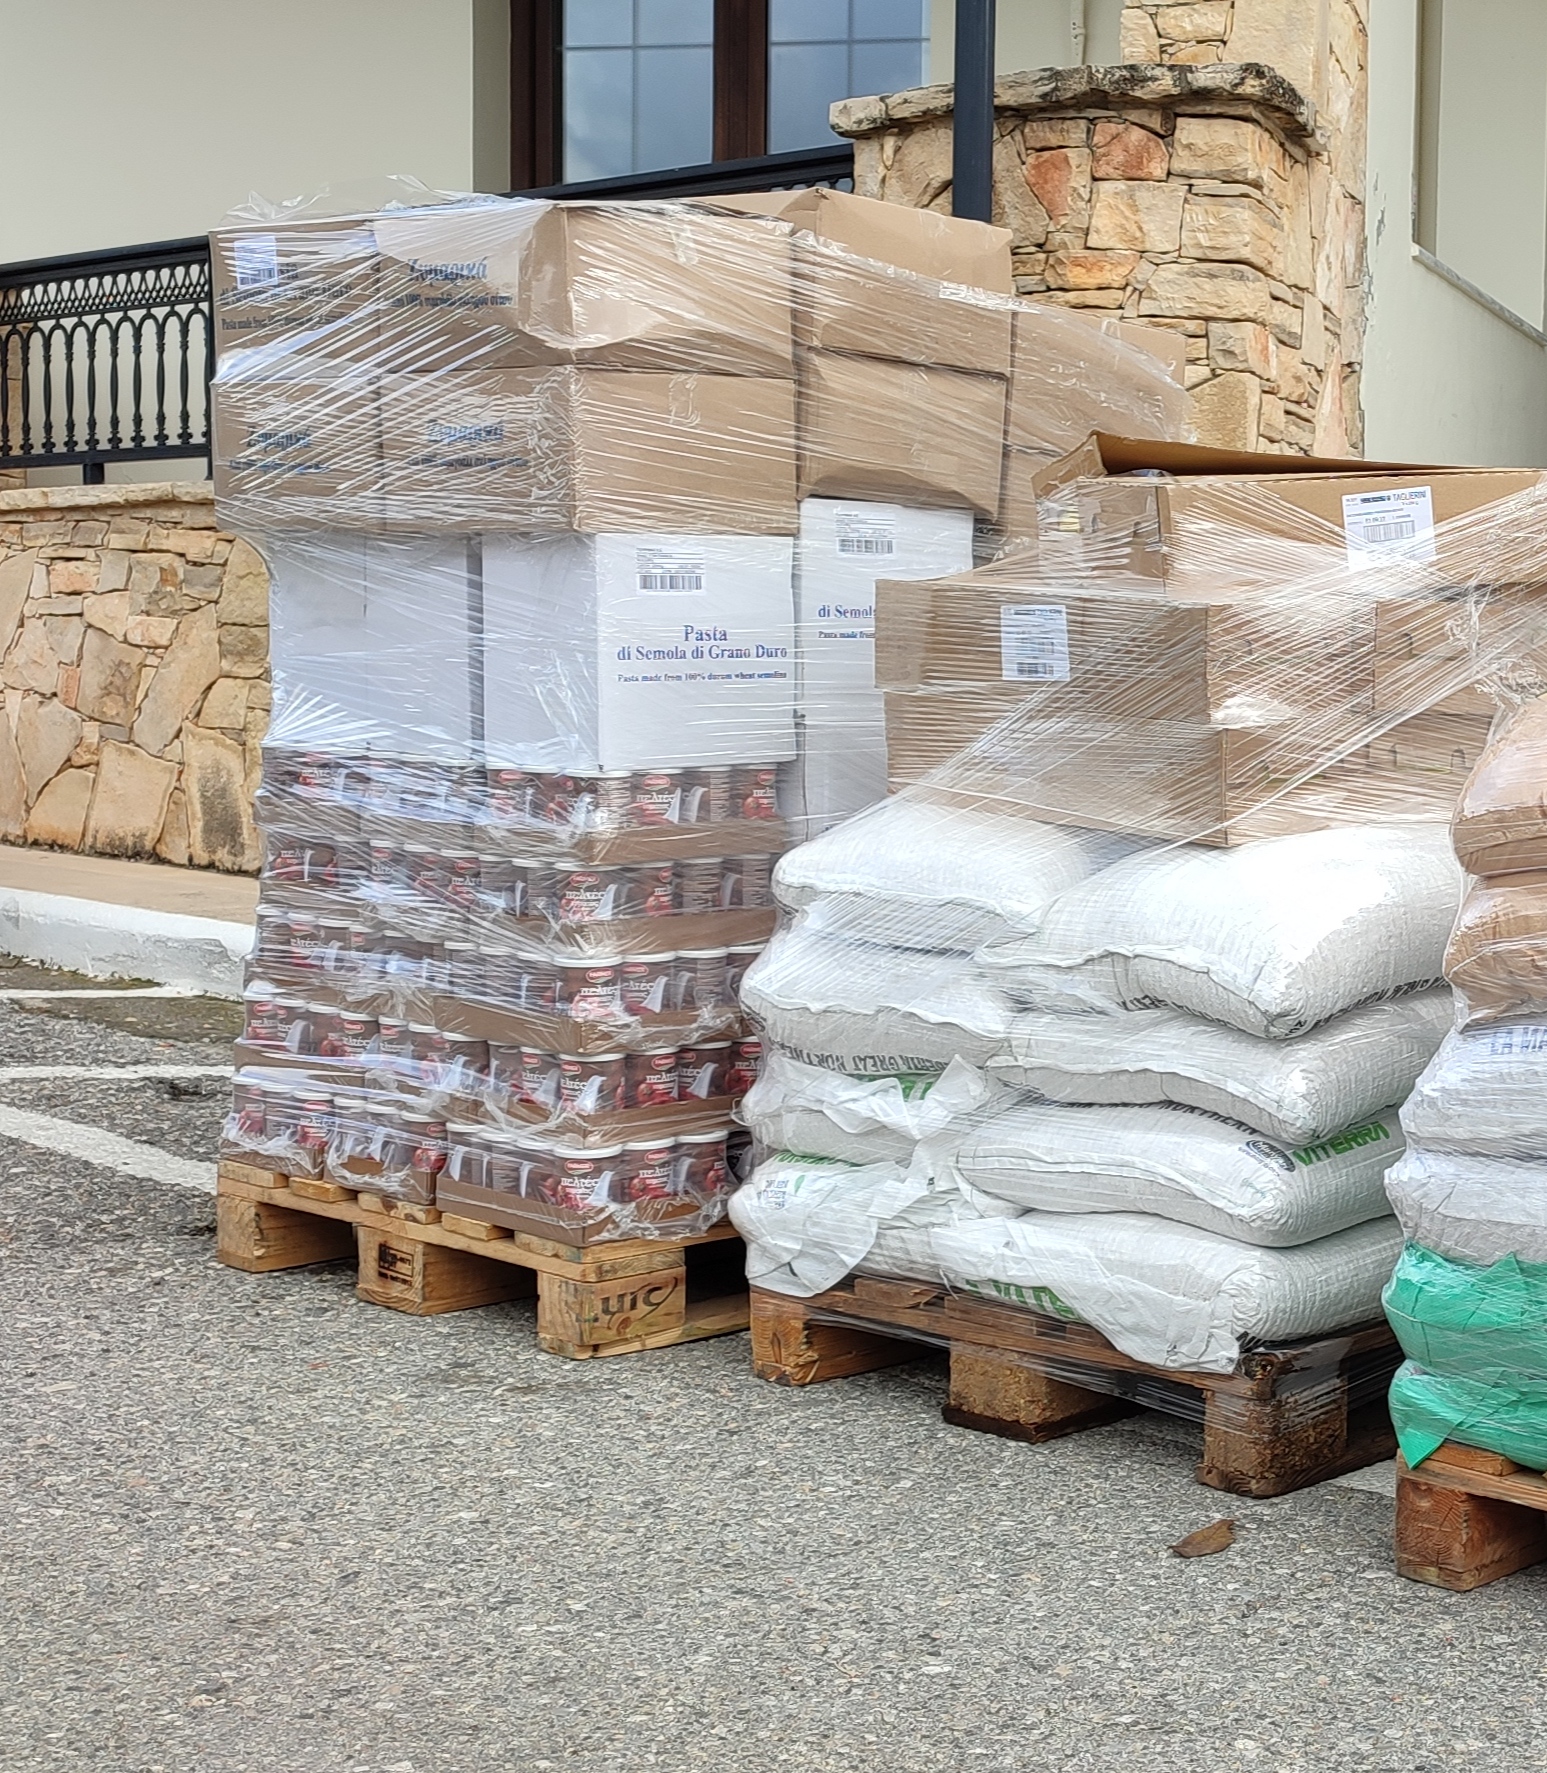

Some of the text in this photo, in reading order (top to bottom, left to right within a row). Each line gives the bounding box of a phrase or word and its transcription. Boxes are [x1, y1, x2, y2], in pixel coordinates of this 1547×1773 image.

[818, 605, 830, 618] di
[683, 624, 728, 642] Pasta
[839, 630, 858, 638] made
[617, 644, 787, 661] di Semola di Grano Duro
[617, 674, 639, 682] Pasta
[641, 674, 662, 682] made
[852, 1054, 899, 1072] GREAT
[1293, 1120, 1392, 1167] VITERRA
